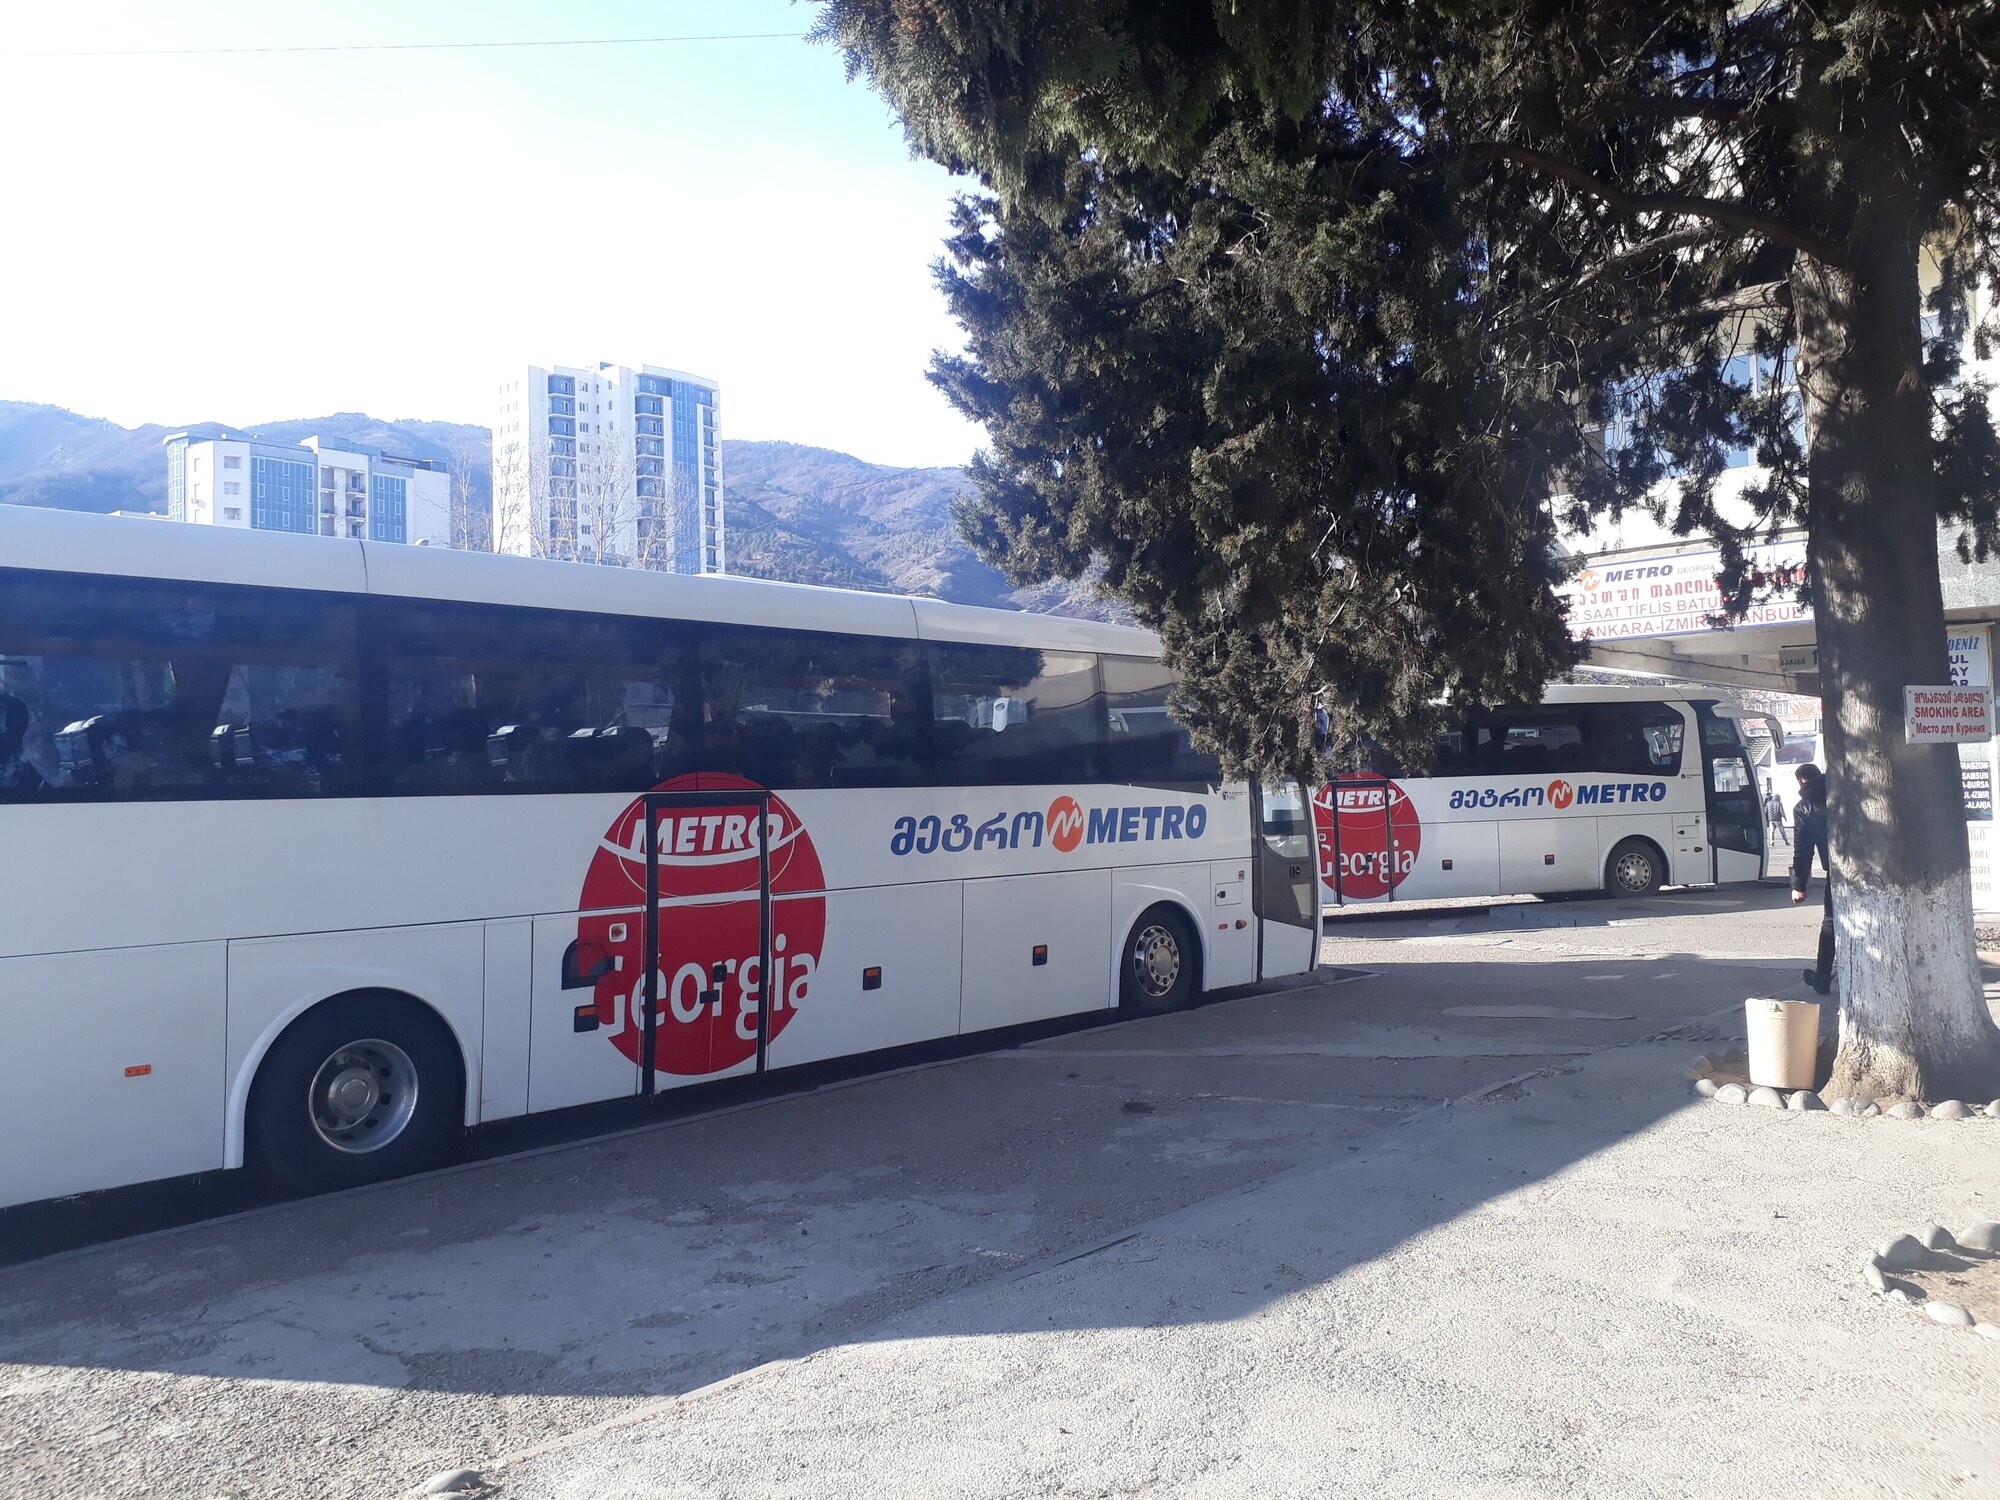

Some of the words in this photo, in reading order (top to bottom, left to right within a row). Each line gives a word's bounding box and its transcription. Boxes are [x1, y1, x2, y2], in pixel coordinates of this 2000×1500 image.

[1605, 564, 1674, 583] METRO
[1677, 563, 1716, 575] GEORGIA
[1650, 577, 1722, 598] თბილის
[1584, 606, 1622, 621] SAAT
[1677, 594, 1725, 612] BATU
[1915, 706, 1959, 718] SMOKING
[1961, 706, 1985, 718] AREA
[1916, 722, 1939, 734] Место
[1941, 724, 1954, 735] для
[1956, 722, 1986, 736] Курения
[1962, 771, 1989, 780] SAMSUN
[1325, 788, 1397, 807] METRO
[1449, 786, 1545, 810] მეტრო
[1576, 781, 1667, 805] METRO
[630, 812, 784, 854] METRO
[890, 811, 1045, 856] მეტრო
[1086, 803, 1207, 844] METRO
[584, 933, 816, 1040] Georgia
